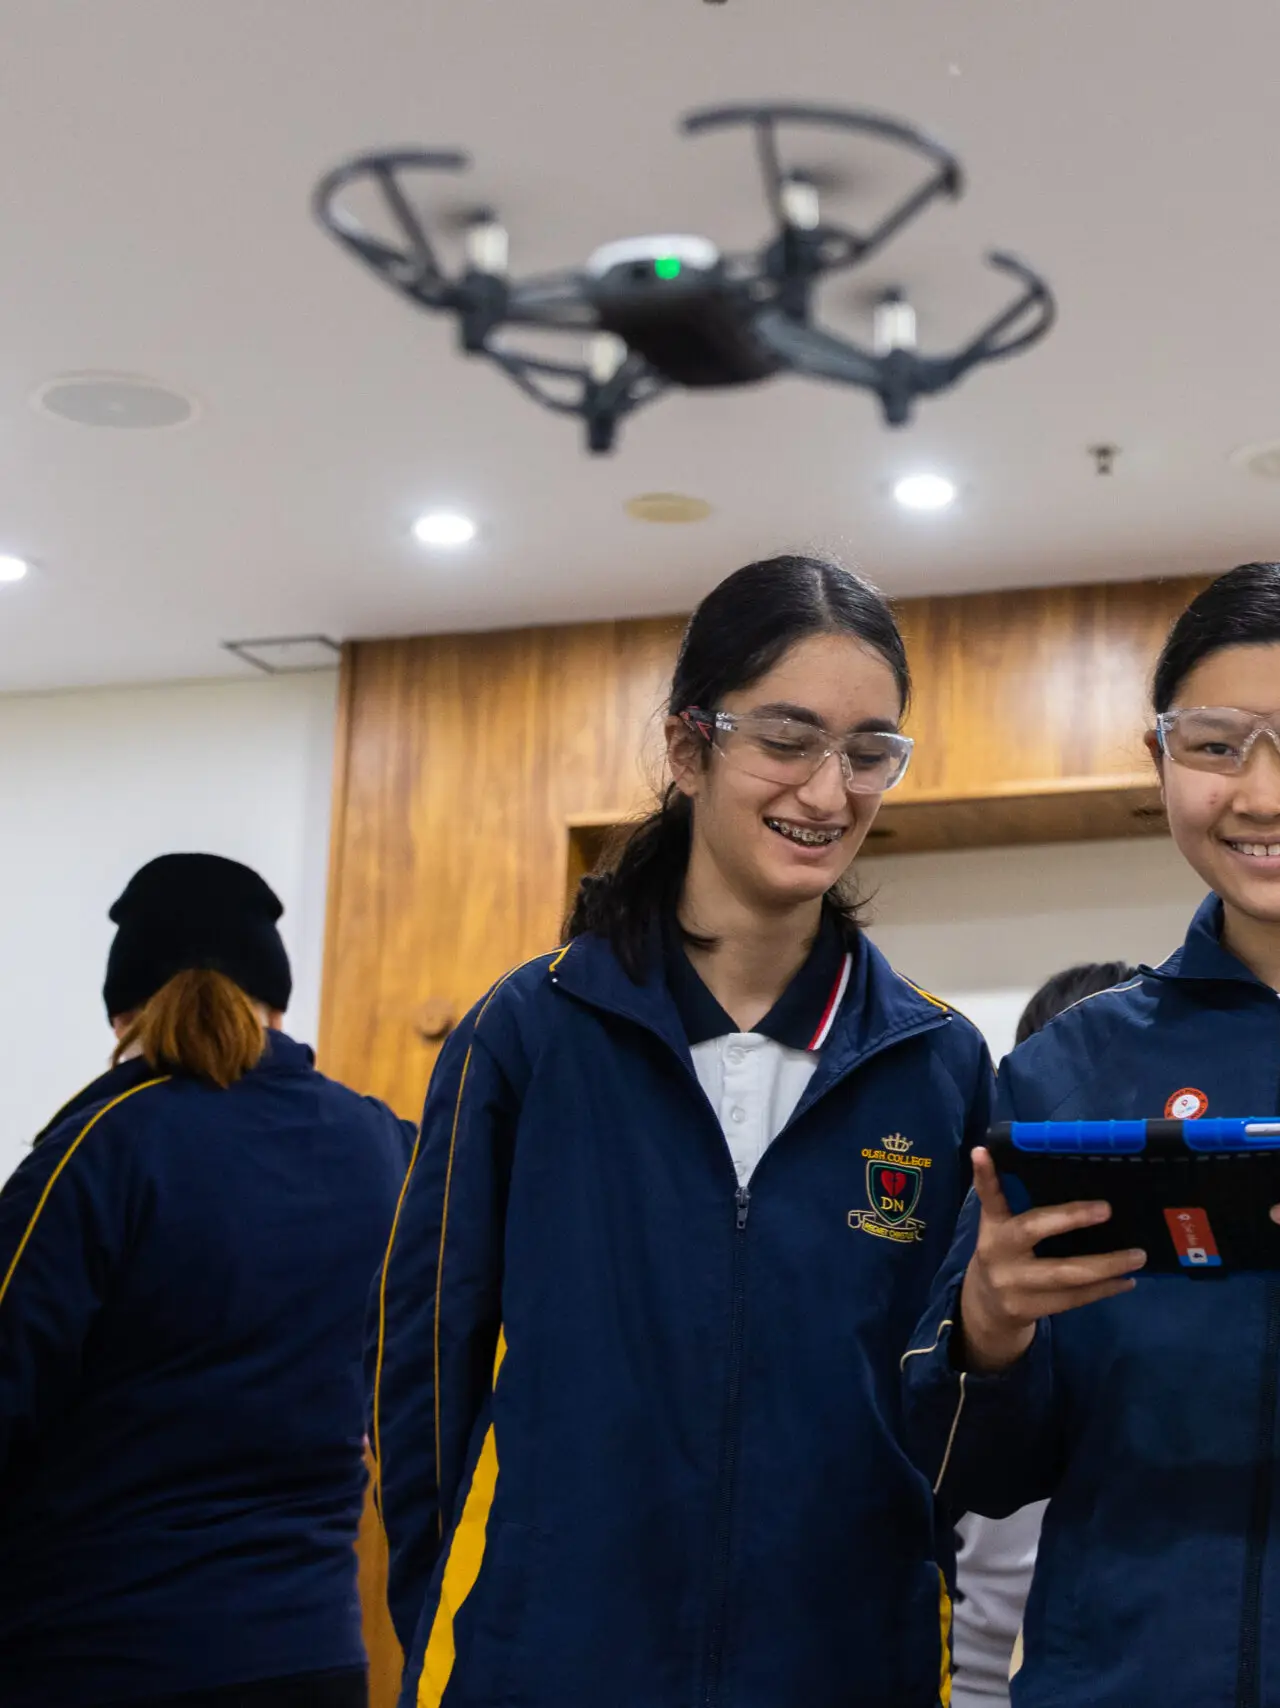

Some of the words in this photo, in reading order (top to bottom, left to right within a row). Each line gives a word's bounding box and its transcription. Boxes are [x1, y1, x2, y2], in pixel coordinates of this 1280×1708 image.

[861, 1148, 886, 1161] OLSH
[887, 1153, 932, 1168] COLLEGE
[881, 1196, 905, 1212] DN
